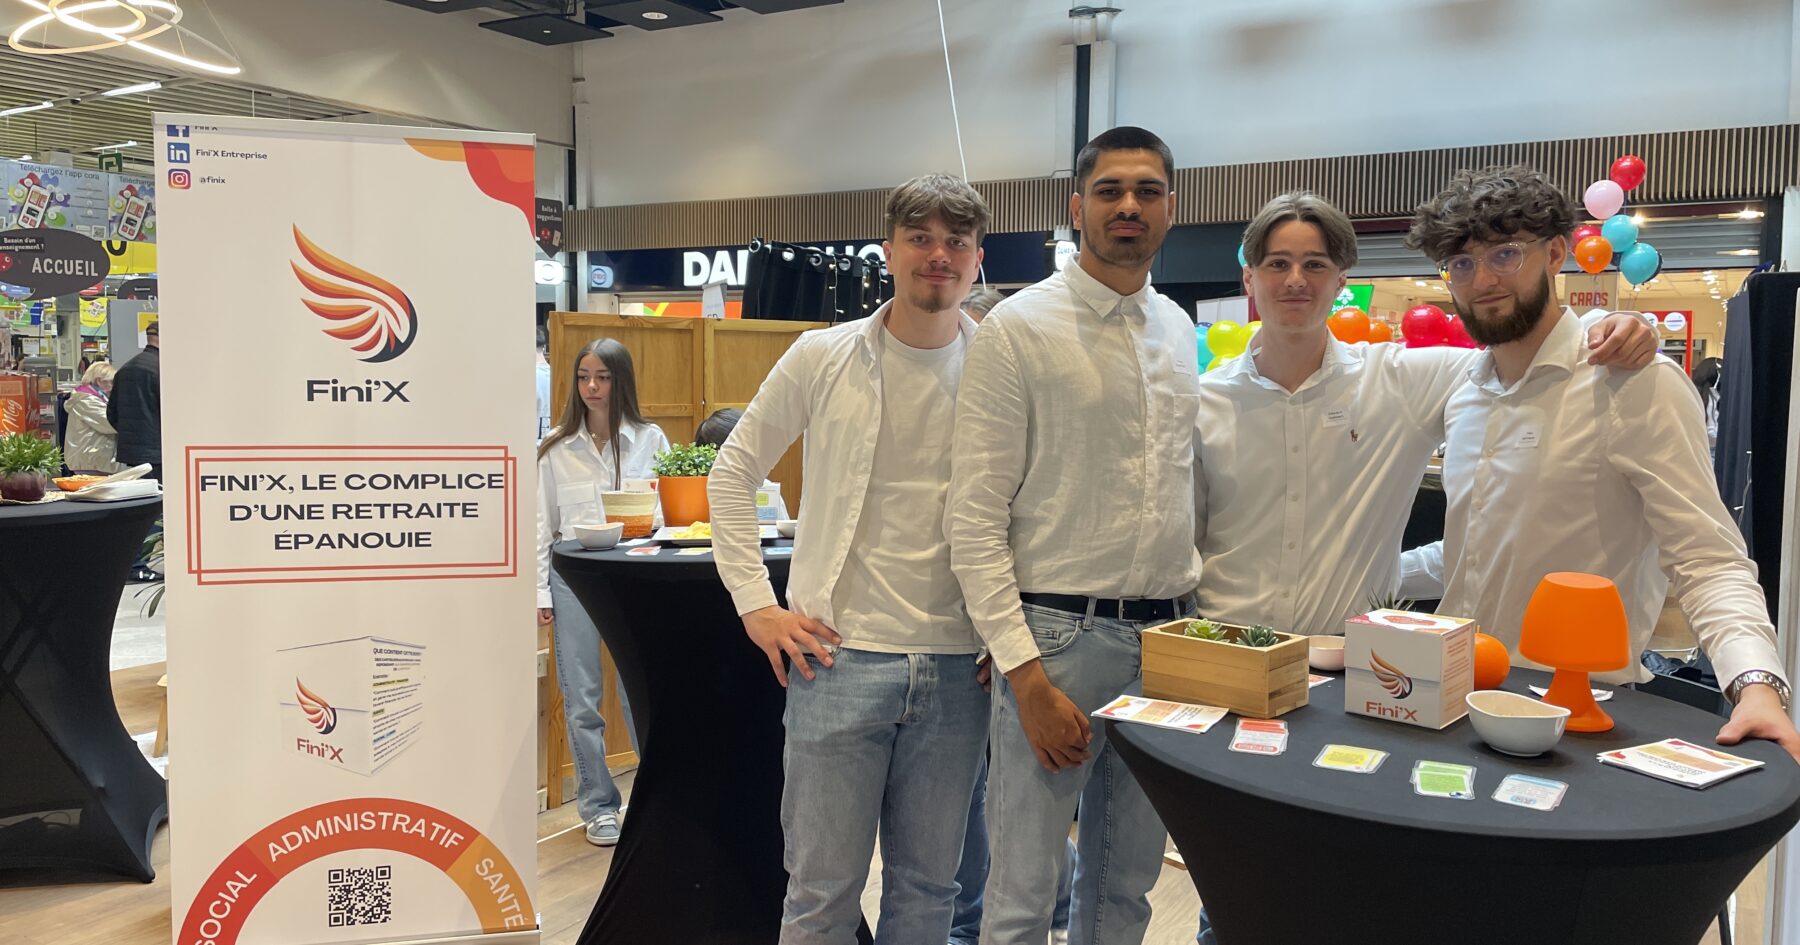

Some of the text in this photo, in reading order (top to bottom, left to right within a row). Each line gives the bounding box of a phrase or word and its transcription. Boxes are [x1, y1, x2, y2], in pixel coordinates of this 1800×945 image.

[221, 150, 268, 160] Entreprise
[32, 257, 98, 277] ACCUEIL
[306, 378, 411, 403] Fini'X
[201, 473, 505, 494] FINI'X, LE COMPLICE
[229, 502, 479, 522] D'UNE RETRAITE
[274, 530, 432, 550] ÉPANOUIE
[1365, 701, 1418, 722] Fini'X
[296, 738, 344, 764] Fini'X
[267, 811, 465, 862] ADMINISTRATIF
[475, 858, 529, 930] SANTÉ
